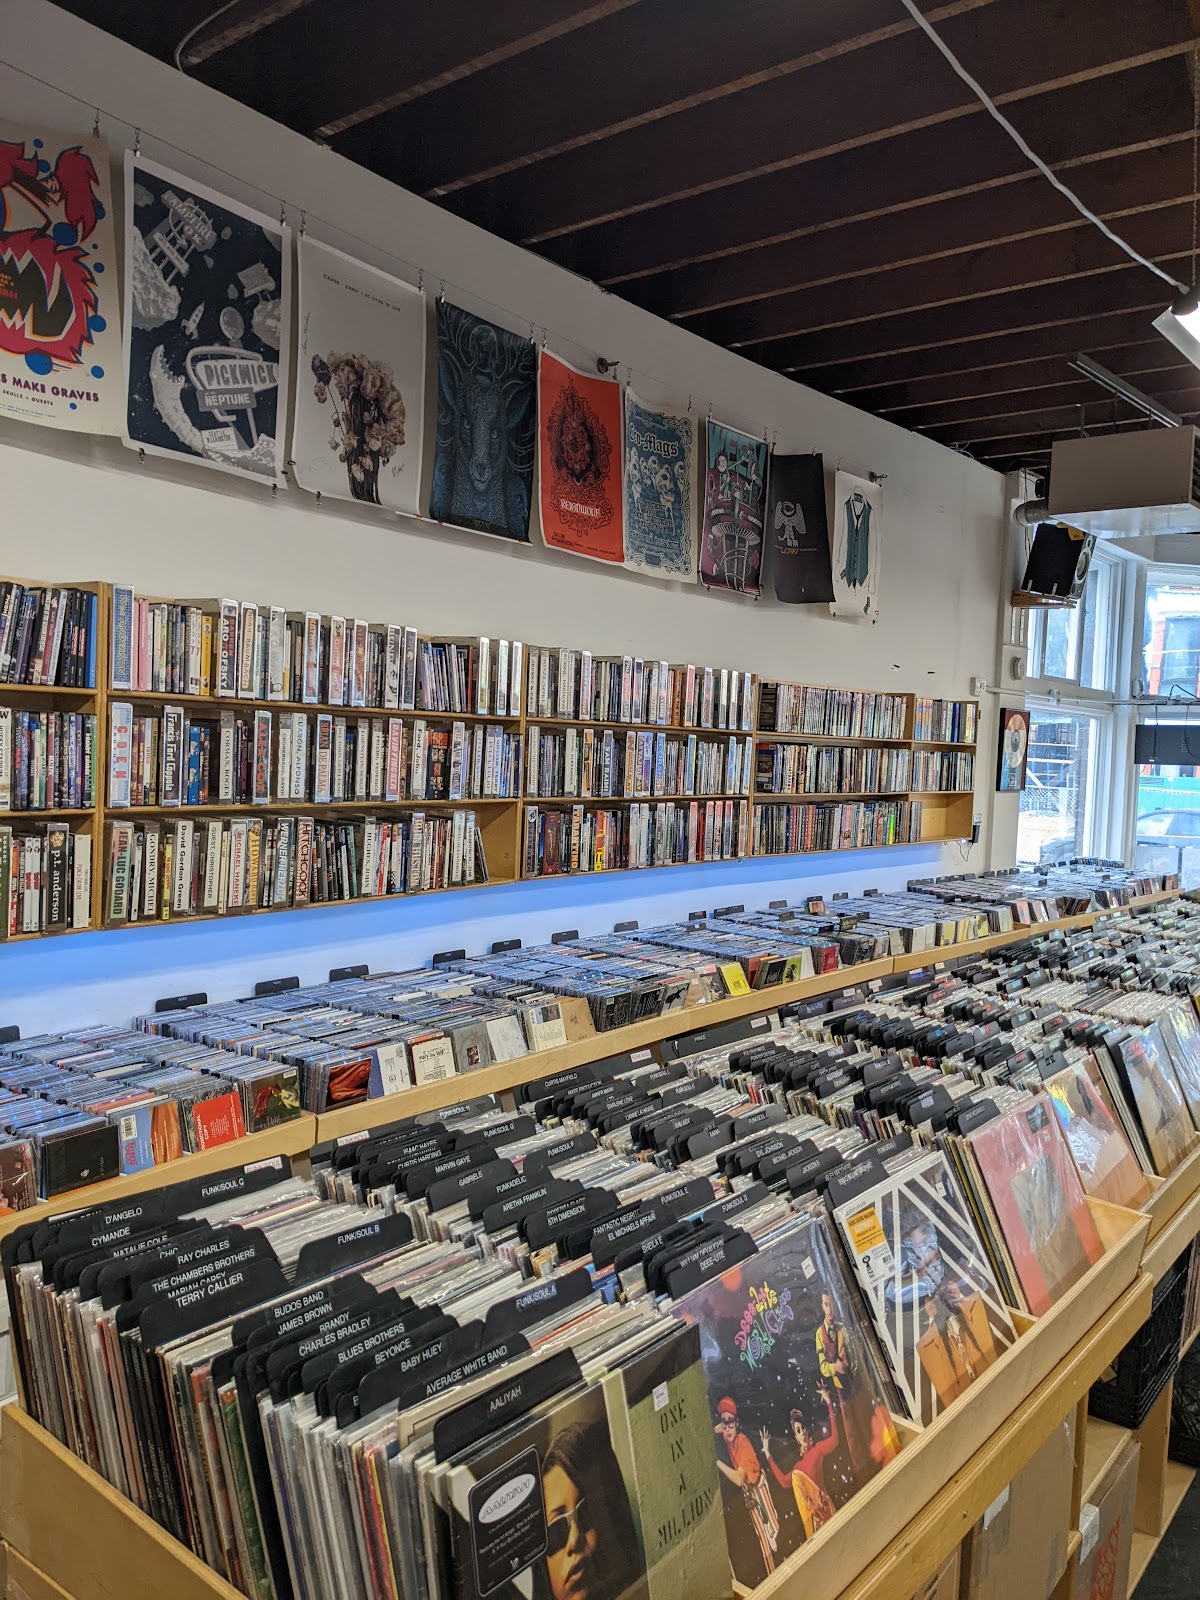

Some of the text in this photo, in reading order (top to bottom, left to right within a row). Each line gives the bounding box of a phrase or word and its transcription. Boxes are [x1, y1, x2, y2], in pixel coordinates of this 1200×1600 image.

[203, 364, 277, 386] PICKWICK
[12, 376, 99, 402] MAKE GRAVES
[31, 396, 53, 406] GUESTS
[204, 393, 250, 407] NEPTUNE
[629, 423, 679, 456] Cro-Mags
[243, 638, 251, 687] BAUMBACH
[320, 722, 328, 749] BRIAN
[115, 725, 128, 779] COEN
[164, 713, 177, 791] Francis Ford Coppola
[255, 722, 267, 793] ALEX COX
[390, 723, 399, 790] DAVID FINCHER
[294, 757, 302, 795] ALFONSO
[317, 751, 328, 793] DE PALMA
[411, 818, 423, 886] JOHN HUSTON
[571, 809, 580, 869] TARANTINO
[113, 831, 128, 915] JEAN-LUC GODARD
[147, 834, 156, 912] GONDRY, MICHEL
[178, 851, 186, 881] Gordon
[277, 822, 290, 902] WERNER HERZOG
[299, 823, 310, 897] HITCHCOCK
[51, 850, 61, 922] p.t. anderson
[207, 852, 216, 899] CHRISTOPHER
[176, 883, 184, 909] Green
[559, 1073, 578, 1083] MAYFIELD
[484, 1124, 509, 1138] FUNK/SOUL
[418, 1150, 442, 1164] HARDING
[548, 1143, 570, 1157] FUNK/SOUL
[764, 1142, 784, 1154] JOHNSON
[434, 1155, 471, 1174] MARVIN GAYE
[201, 1178, 245, 1197] FUNK/SOUL C
[458, 1171, 483, 1187] GABRIELS
[496, 1175, 527, 1194] FUNKADELIC
[502, 1187, 547, 1213] ARETHA FRANKLIN
[661, 1189, 684, 1204] FUNK/SOUL
[722, 1198, 743, 1213] FUNK/SOUL
[105, 1207, 143, 1225] D'ANGELO
[548, 1205, 586, 1227] 5TH DIMENSION
[593, 1215, 620, 1236] FANTASTIC
[614, 1220, 640, 1240] MICHAELS
[639, 1213, 657, 1229] AFFAIR
[91, 1227, 131, 1247] CYMANDE
[337, 1224, 380, 1245] FUNK/SOUL B
[641, 1239, 659, 1254] SHEILA
[177, 1240, 230, 1265] RAY CHARLES
[699, 1250, 725, 1270] DEEE-LITE
[152, 1248, 255, 1293] THE CHAMBERS BROTHERS
[175, 1272, 244, 1308] TERRY CALLIER
[516, 1287, 551, 1309] FUNK/SOUL
[273, 1290, 324, 1318] BUDOS BAND
[278, 1303, 333, 1335] JAMES BROWN
[319, 1311, 350, 1333] BRANDY
[298, 1317, 371, 1357] CHARLES BRADLEY
[338, 1323, 405, 1364] BLUES BROTHERS
[375, 1338, 412, 1365] BEYONCE
[400, 1341, 443, 1373] BABY HUEY
[425, 1345, 508, 1397] AVERAGE WHITE BAND
[490, 1385, 523, 1413] AALIYAH
[660, 1398, 688, 1434] ONE
[671, 1437, 686, 1464] IN
[678, 1473, 687, 1495] A
[481, 1477, 530, 1520] AALIYAH
[658, 1487, 714, 1549] MILLION
